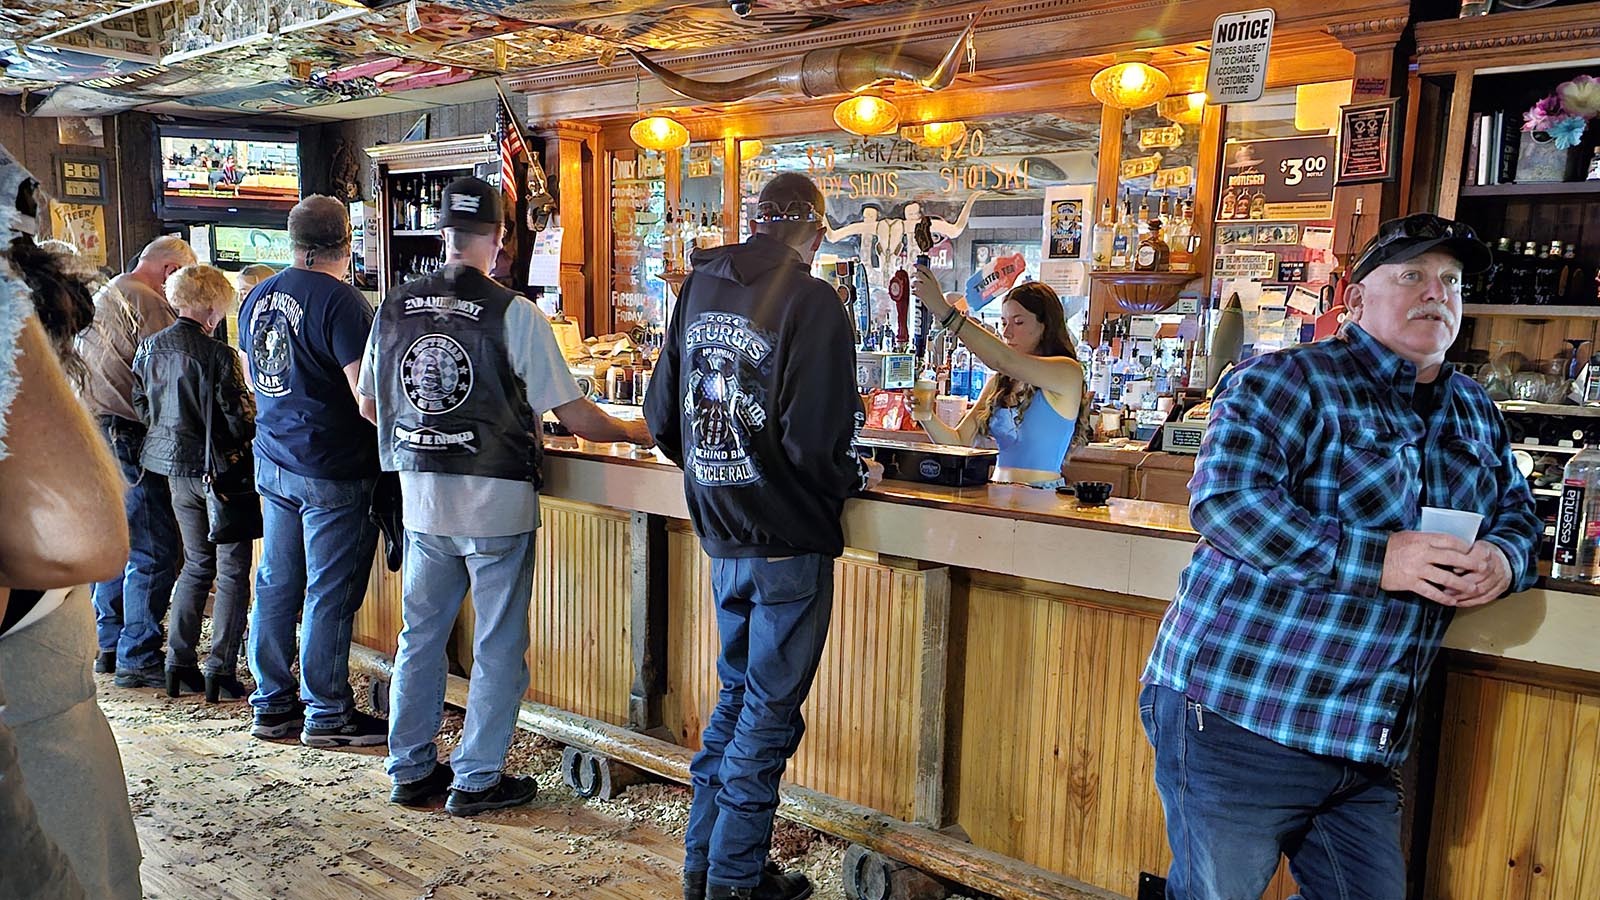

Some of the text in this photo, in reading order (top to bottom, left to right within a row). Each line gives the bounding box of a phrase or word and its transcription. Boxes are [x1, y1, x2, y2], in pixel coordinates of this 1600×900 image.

[1217, 18, 1270, 43] NOTICE
[1215, 43, 1266, 56] PRICES SUBJECT
[1221, 54, 1256, 65] TO CHANGE
[1215, 64, 1260, 76] ACCORDING TO
[1217, 75, 1254, 86] CUSTOMERS
[1220, 85, 1248, 95] ATTITUDE
[940, 160, 1029, 193] SHOTSKI
[849, 171, 899, 200] SHOTS
[55, 203, 83, 221] FREE
[64, 206, 98, 228] BEER!
[973, 270, 1000, 293] TWISTED
[1001, 264, 1016, 278] TEA
[615, 308, 644, 324] FRIDAY
[708, 315, 740, 326] 2024
[686, 323, 766, 361] STURGIS
[258, 372, 281, 387] BAR
[1560, 489, 1577, 544] essentia
